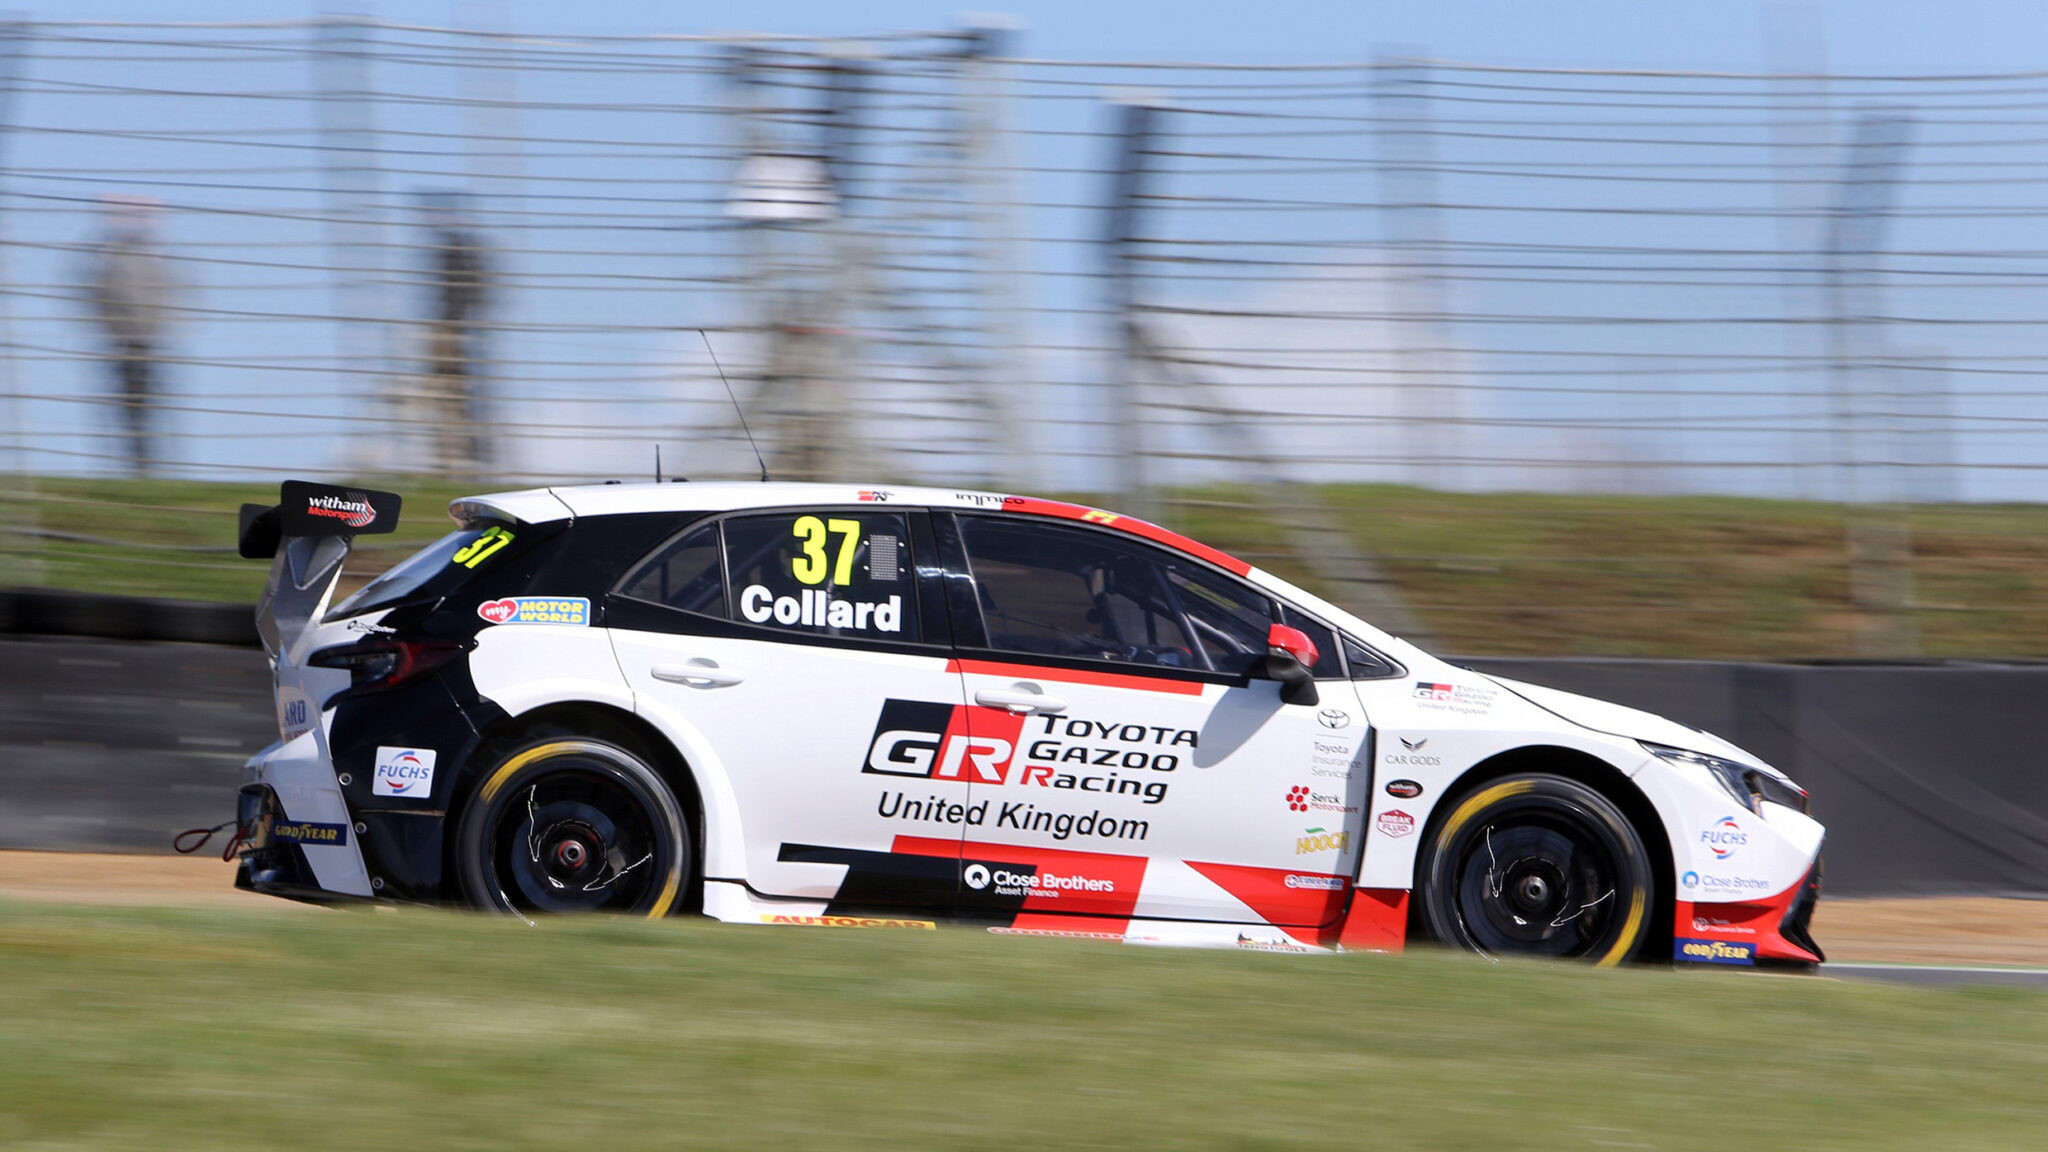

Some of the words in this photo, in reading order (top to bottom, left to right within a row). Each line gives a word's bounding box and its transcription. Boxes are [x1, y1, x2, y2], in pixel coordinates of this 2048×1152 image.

[309, 496, 367, 511] witham
[452, 526, 516, 569] 37
[792, 515, 860, 586] 37
[519, 601, 584, 613] MOTOR
[519, 612, 584, 623] WORLD
[741, 584, 901, 632] Collard
[1038, 712, 1200, 749] TOYOTA
[868, 729, 1013, 782] GR
[1029, 740, 1179, 772] GAZOO
[1314, 741, 1349, 754] Toyota
[1385, 754, 1408, 765] CAR
[1410, 755, 1441, 767] GODS
[378, 764, 430, 780] FUCHS
[1020, 765, 1168, 804] Racing
[878, 791, 988, 826] United
[997, 801, 1149, 841] Kingdom
[1700, 830, 1748, 846] FUCHS
[993, 870, 1041, 887] Close
[1043, 873, 1115, 892] Brothers
[994, 886, 1022, 896] Asset
[1023, 887, 1060, 898] Finance
